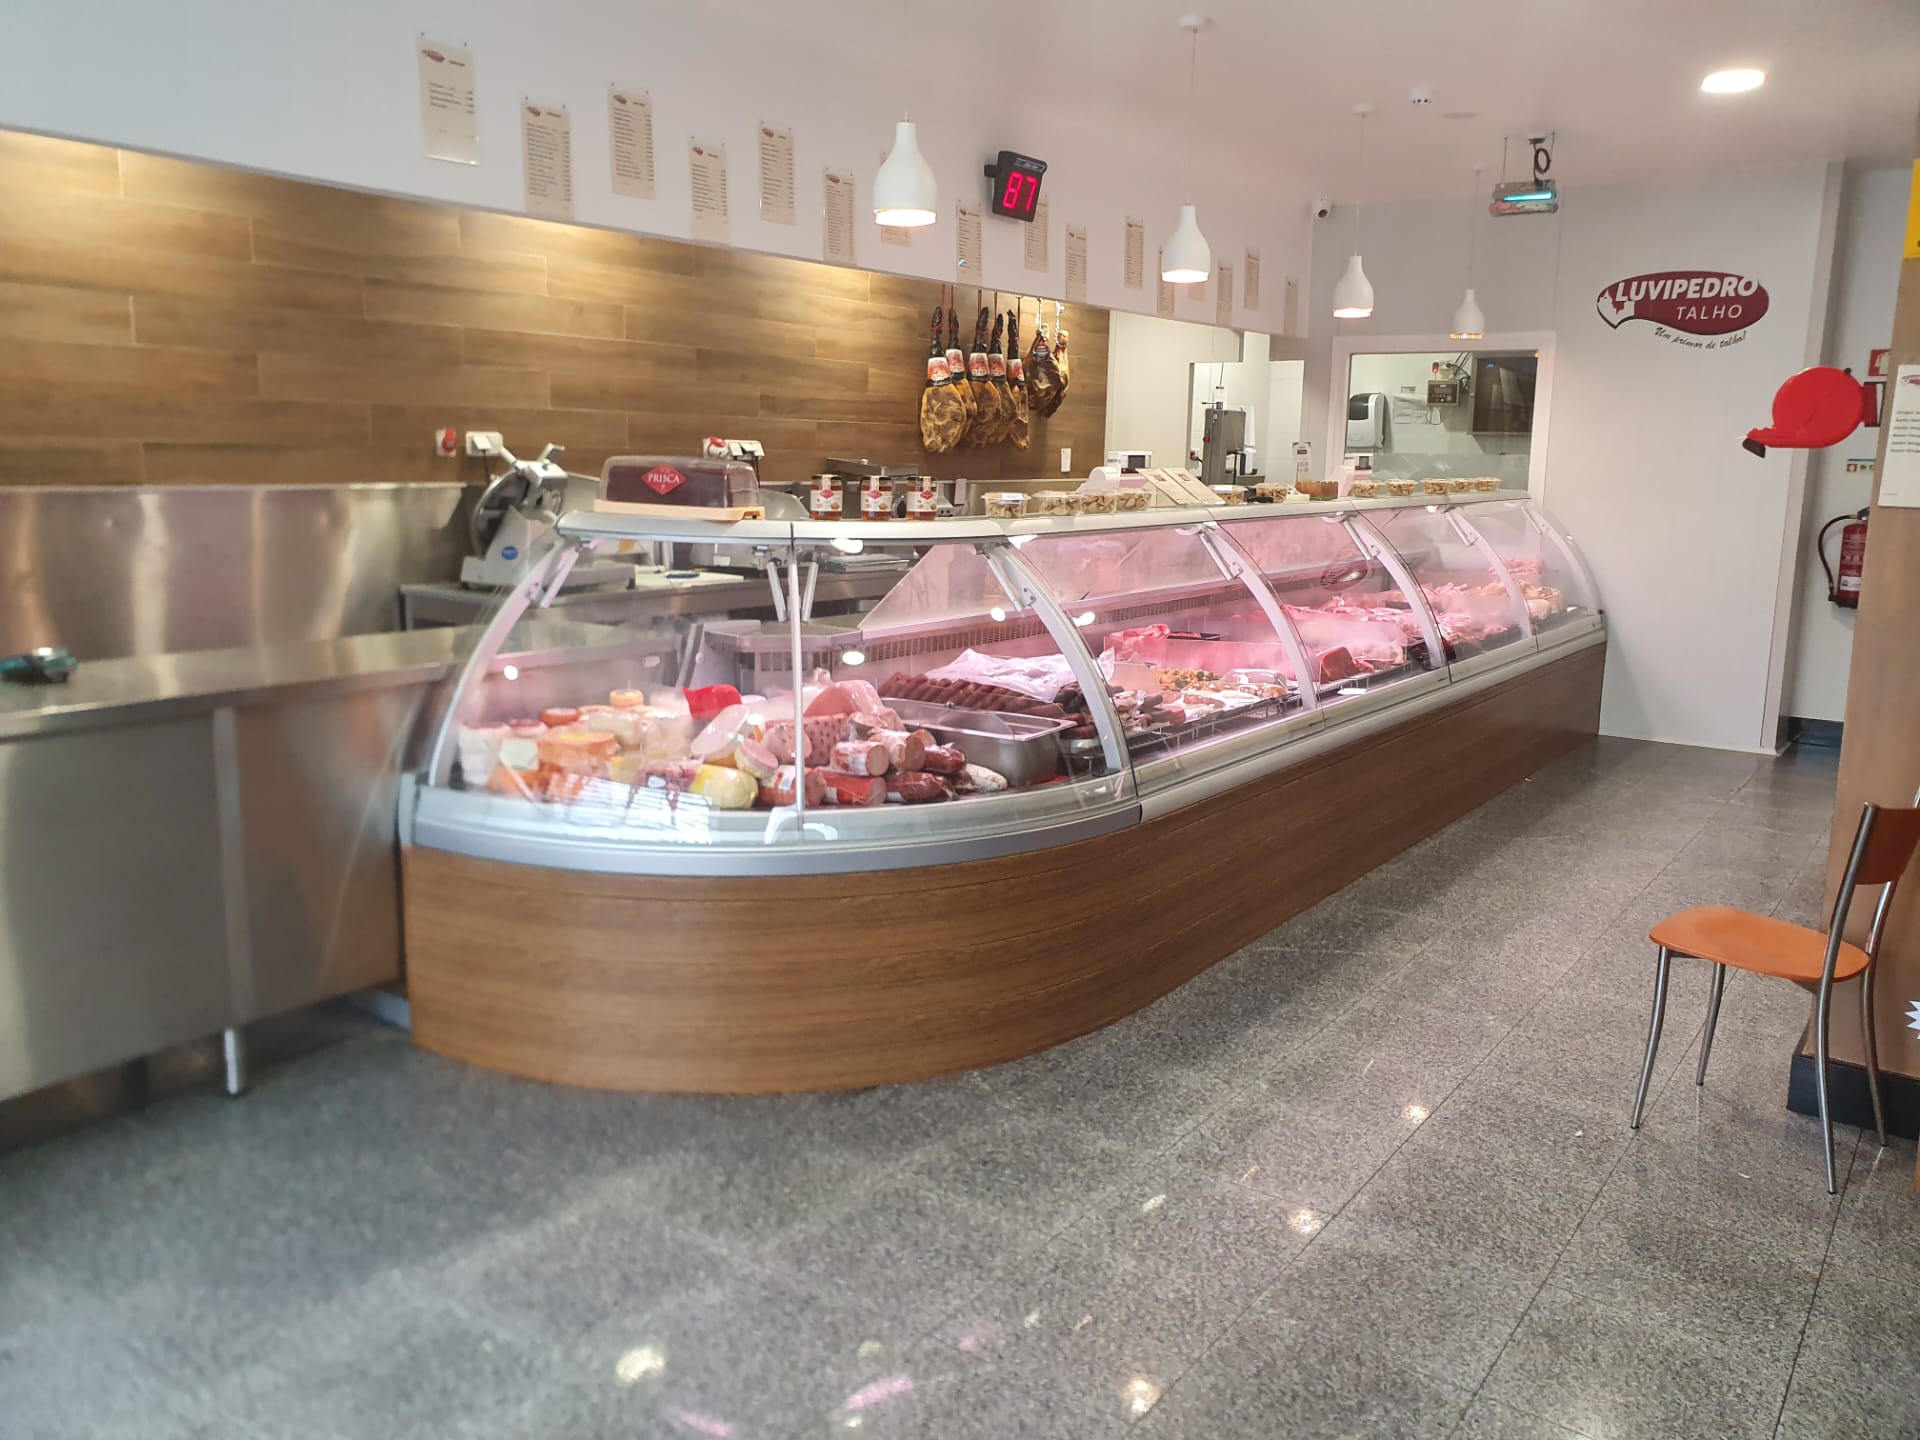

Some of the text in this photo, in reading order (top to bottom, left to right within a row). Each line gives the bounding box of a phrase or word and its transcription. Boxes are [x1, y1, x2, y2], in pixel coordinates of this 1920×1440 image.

[1003, 171, 1037, 212] 87
[1616, 276, 1758, 302] LUVIPEDRO
[1676, 304, 1743, 320] TALHO
[1705, 340, 1716, 349] de
[648, 472, 680, 484] PRISCA
